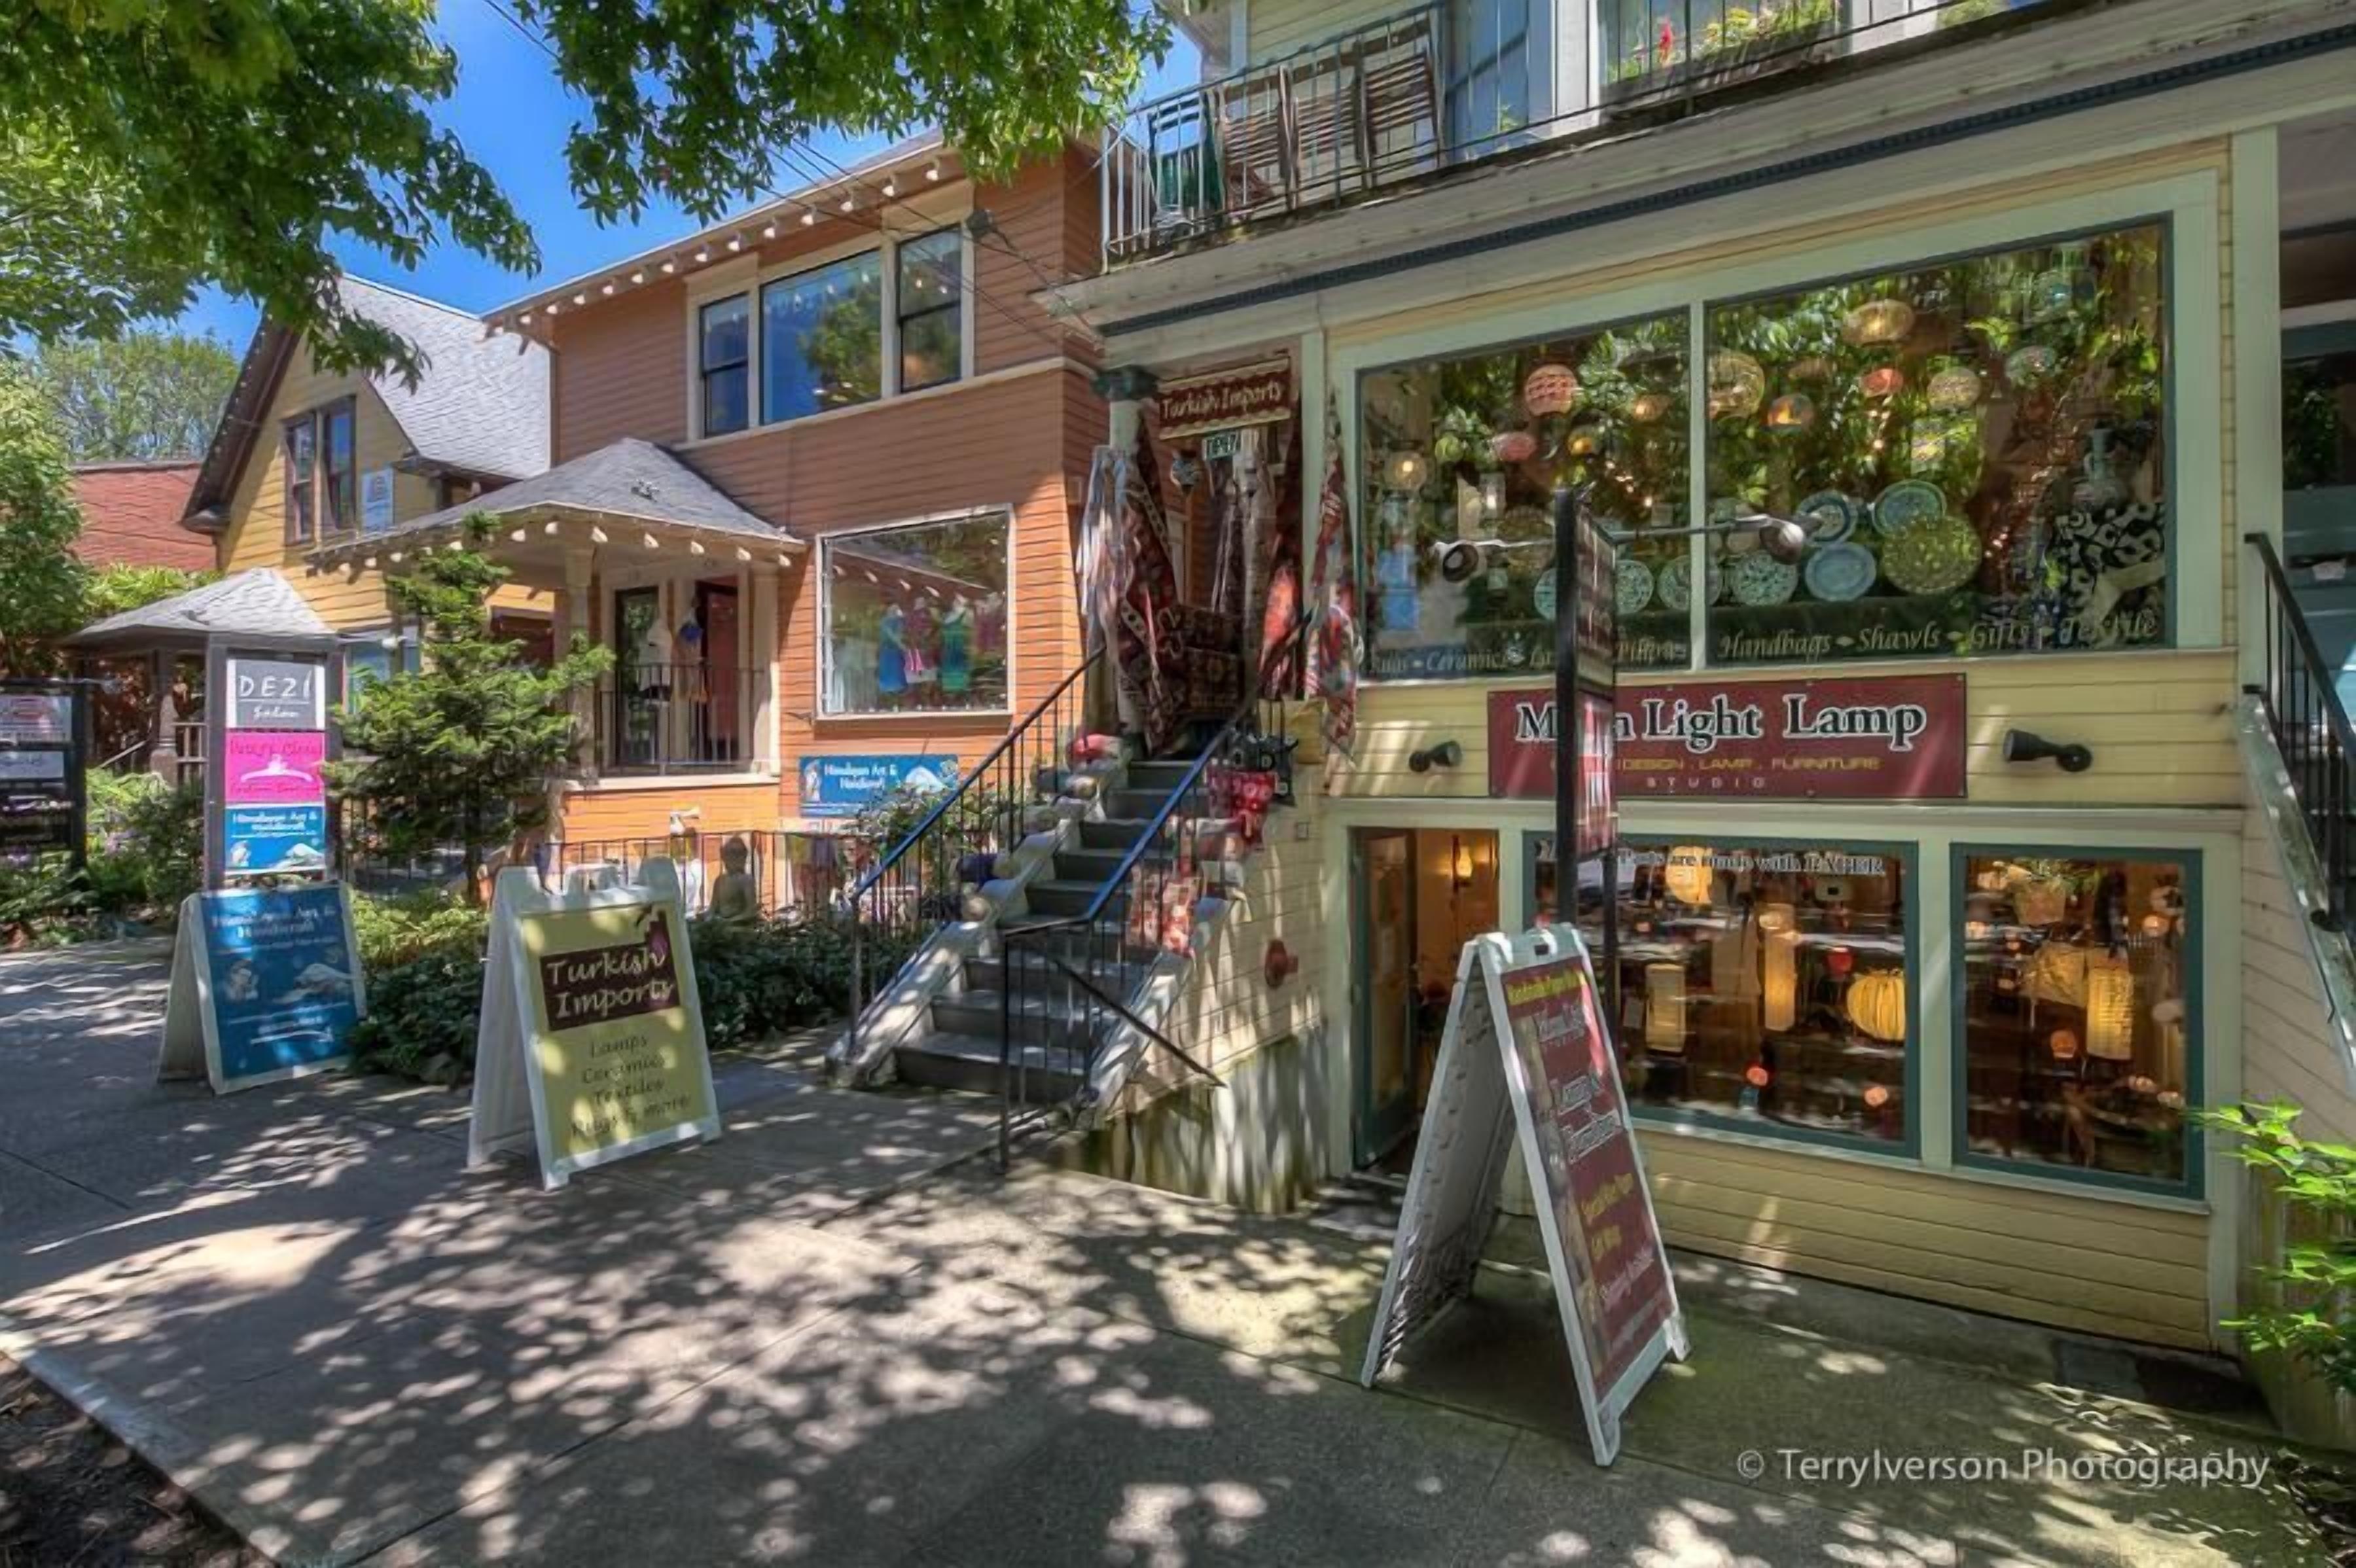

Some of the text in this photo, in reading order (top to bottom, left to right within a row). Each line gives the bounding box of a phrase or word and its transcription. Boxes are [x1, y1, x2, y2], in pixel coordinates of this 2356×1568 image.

[1163, 380, 1281, 419] Turkish Imports
[1718, 631, 1832, 662] Handbags
[1859, 620, 1940, 653] Shawls
[1516, 694, 1927, 753] Mn Light Lamp
[1647, 777, 1766, 789] STUDIO
[546, 944, 666, 985] Turkish
[554, 980, 675, 1018] Imports
